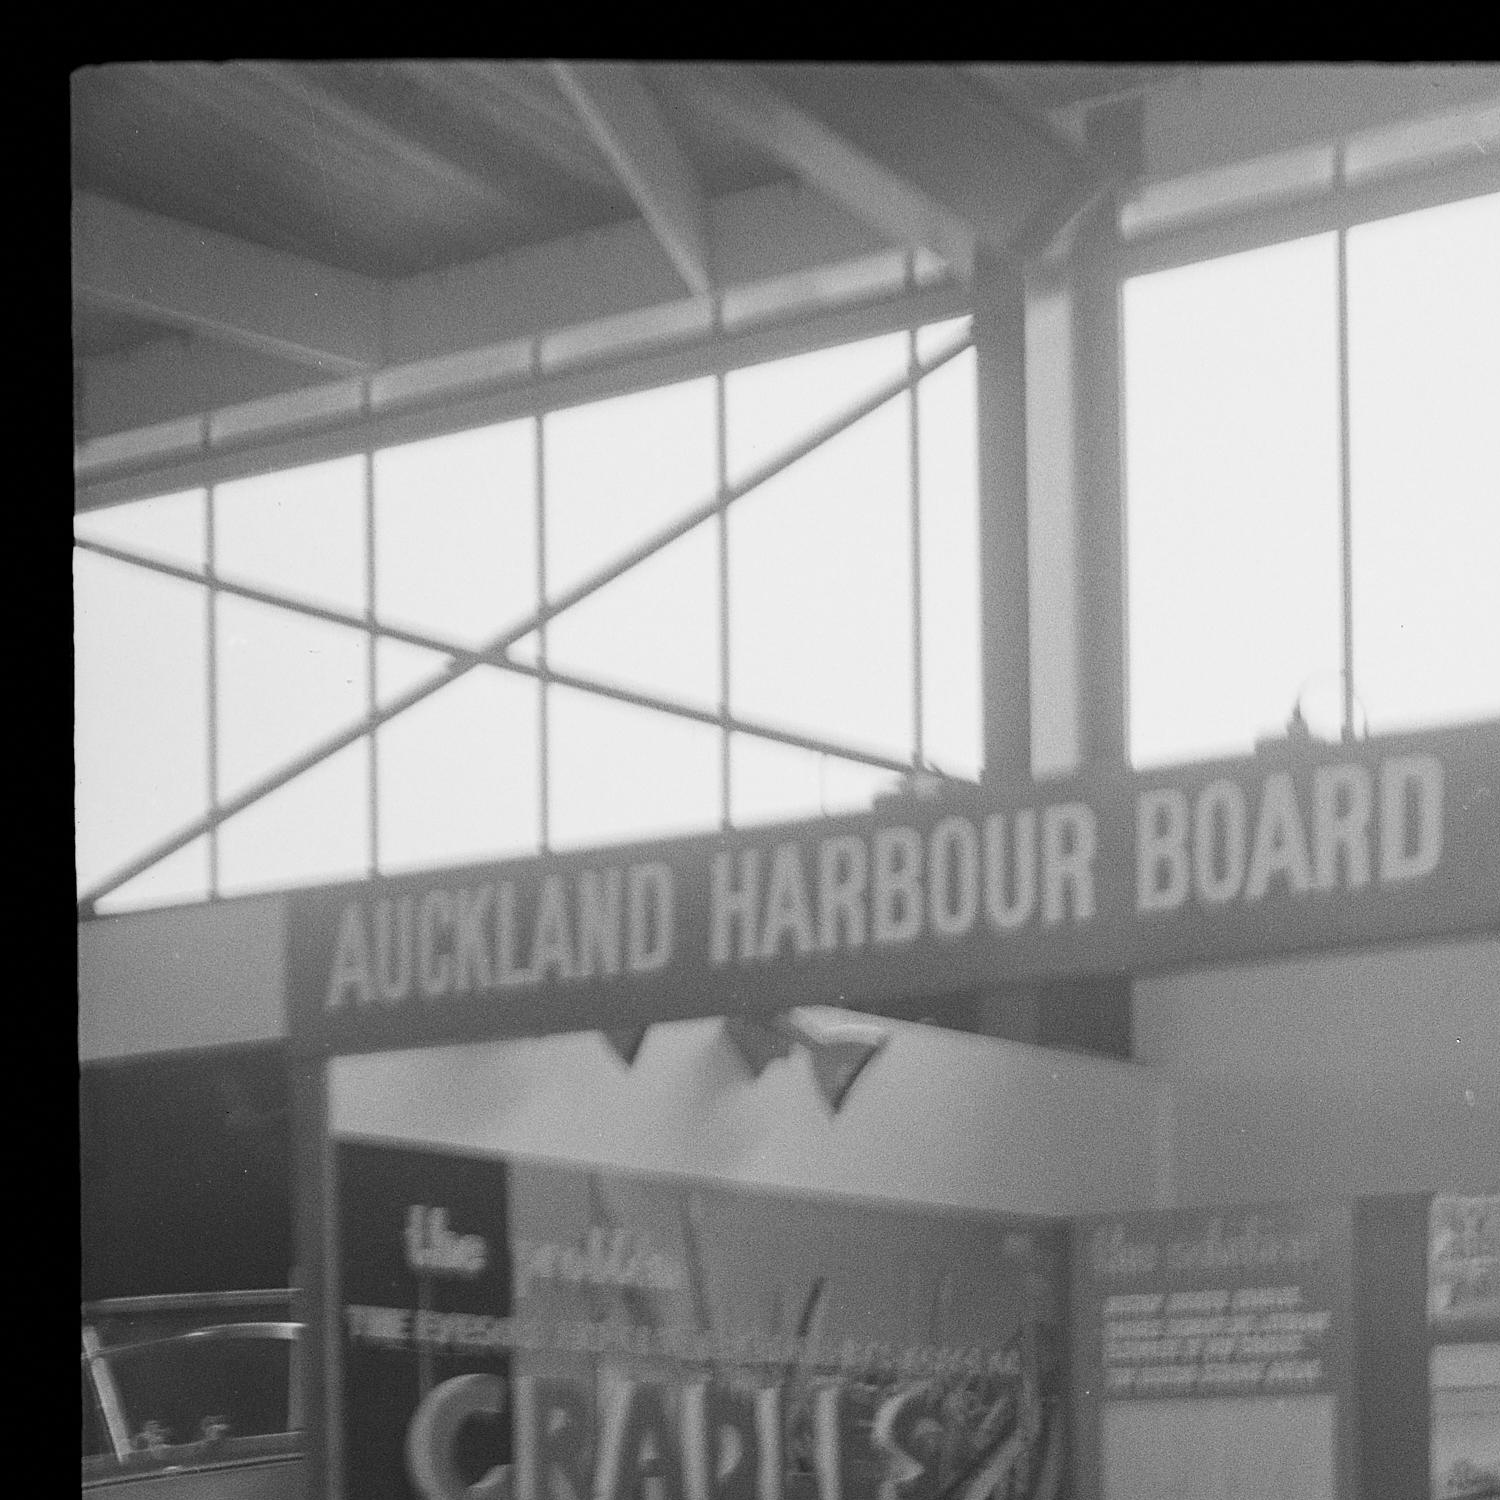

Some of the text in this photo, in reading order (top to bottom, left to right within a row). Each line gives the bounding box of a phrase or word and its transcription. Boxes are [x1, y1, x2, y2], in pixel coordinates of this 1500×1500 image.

[327, 758, 1442, 1010] AUCKLAND HARBOUR BOARD
